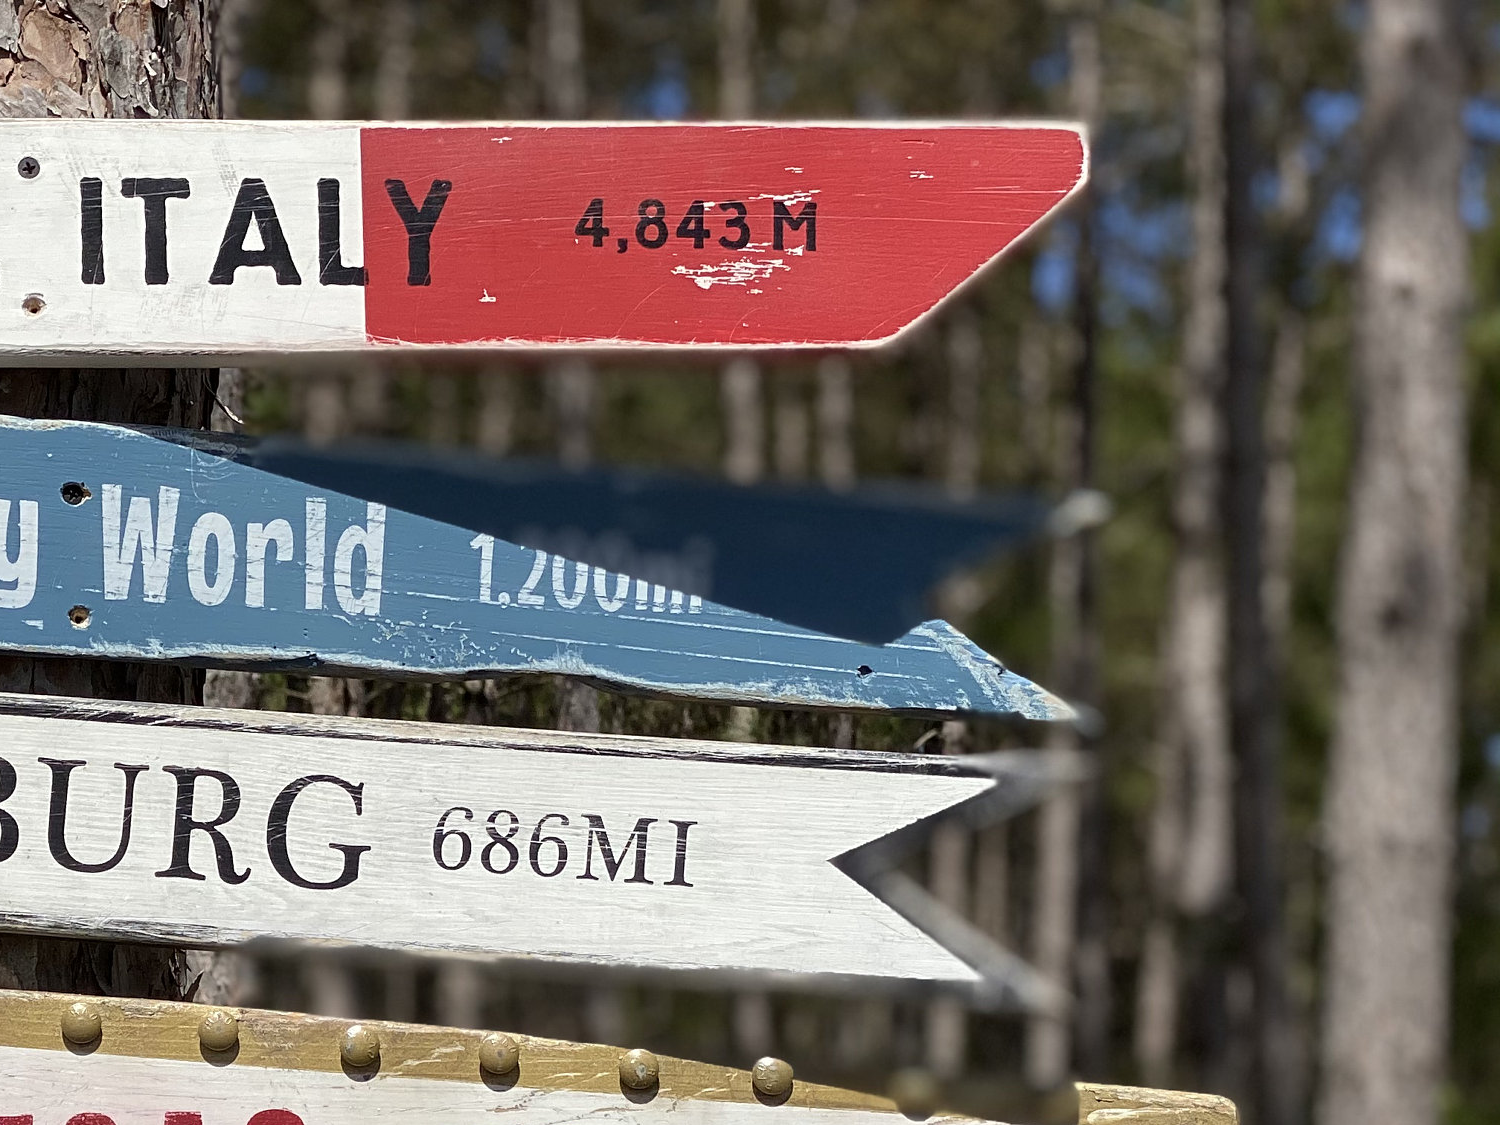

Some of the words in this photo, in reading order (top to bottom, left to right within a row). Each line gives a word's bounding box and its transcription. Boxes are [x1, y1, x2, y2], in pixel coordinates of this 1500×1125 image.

[81, 176, 453, 287] ITALY
[574, 198, 751, 253] 4,843
[772, 200, 817, 252] M
[101, 483, 386, 617] World
[469, 532, 704, 614] 1.200
[432, 806, 698, 888] 686MI
